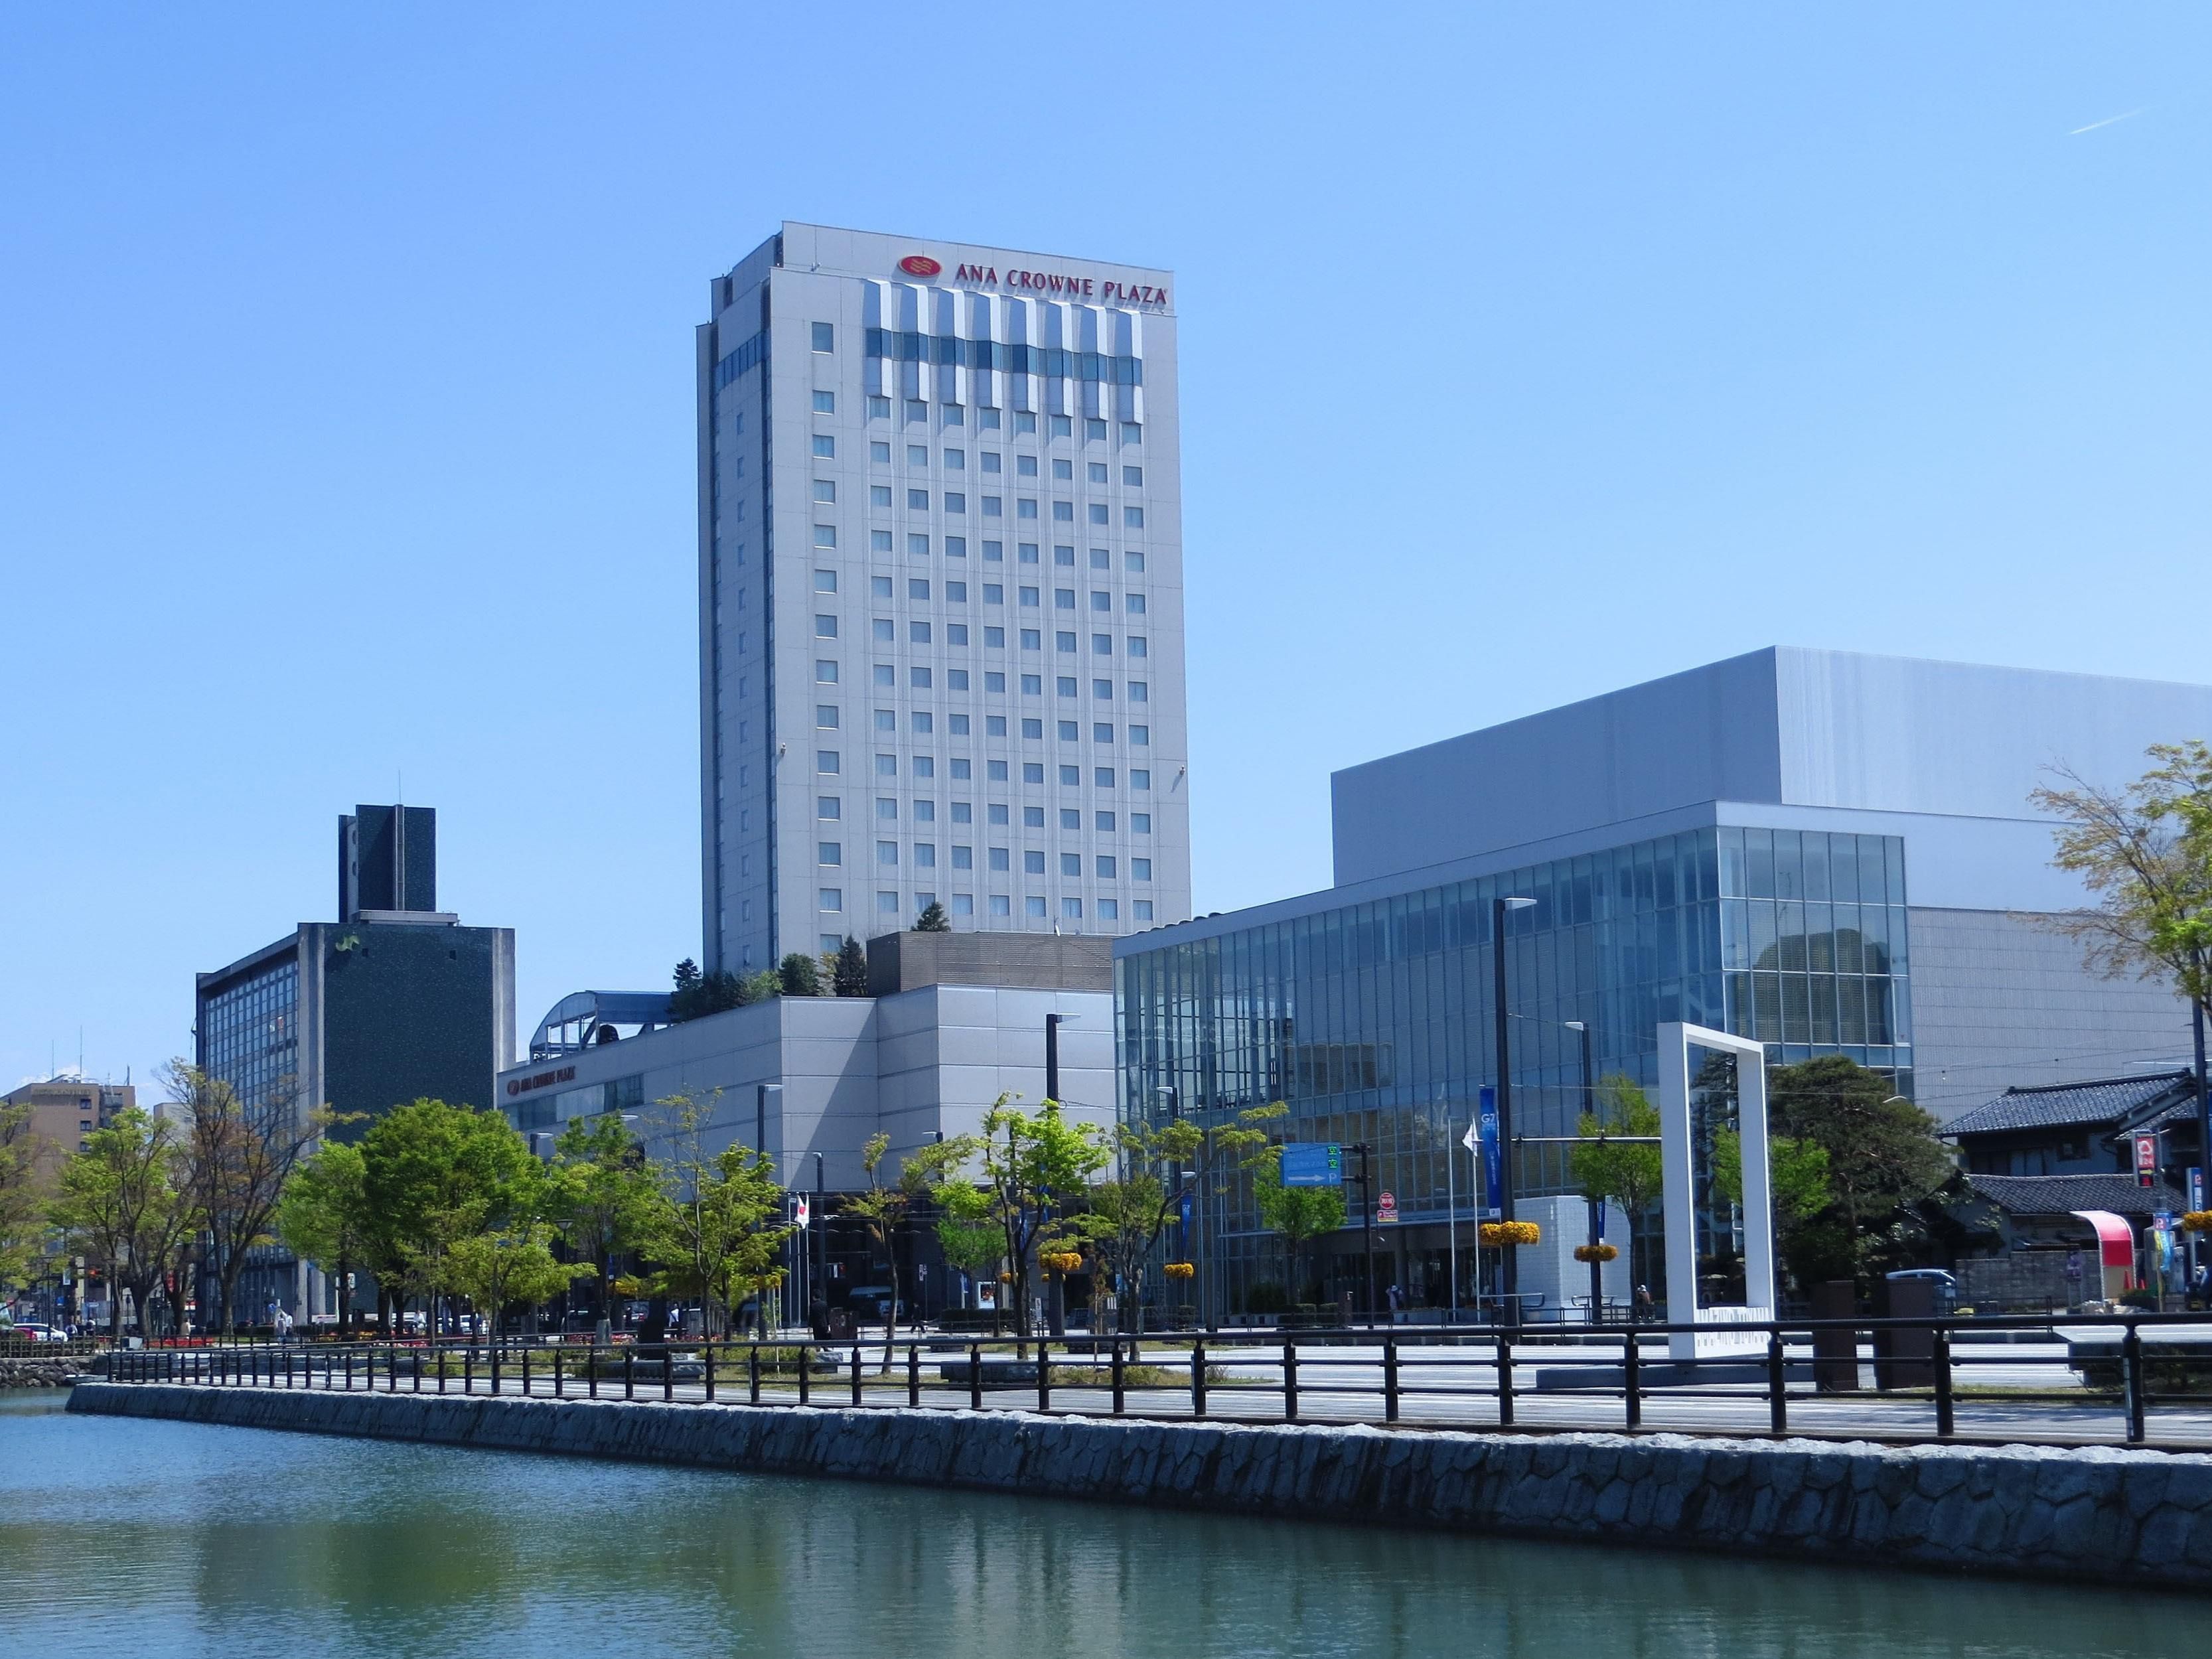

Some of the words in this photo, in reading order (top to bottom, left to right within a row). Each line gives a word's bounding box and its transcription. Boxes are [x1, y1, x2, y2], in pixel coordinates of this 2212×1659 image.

[956, 263, 998, 285] ANA
[1007, 269, 1093, 296] CROWNE
[1104, 281, 1167, 305] PLAZA
[1481, 1114, 1495, 1123] G7
[1329, 1173, 1337, 1183] P
